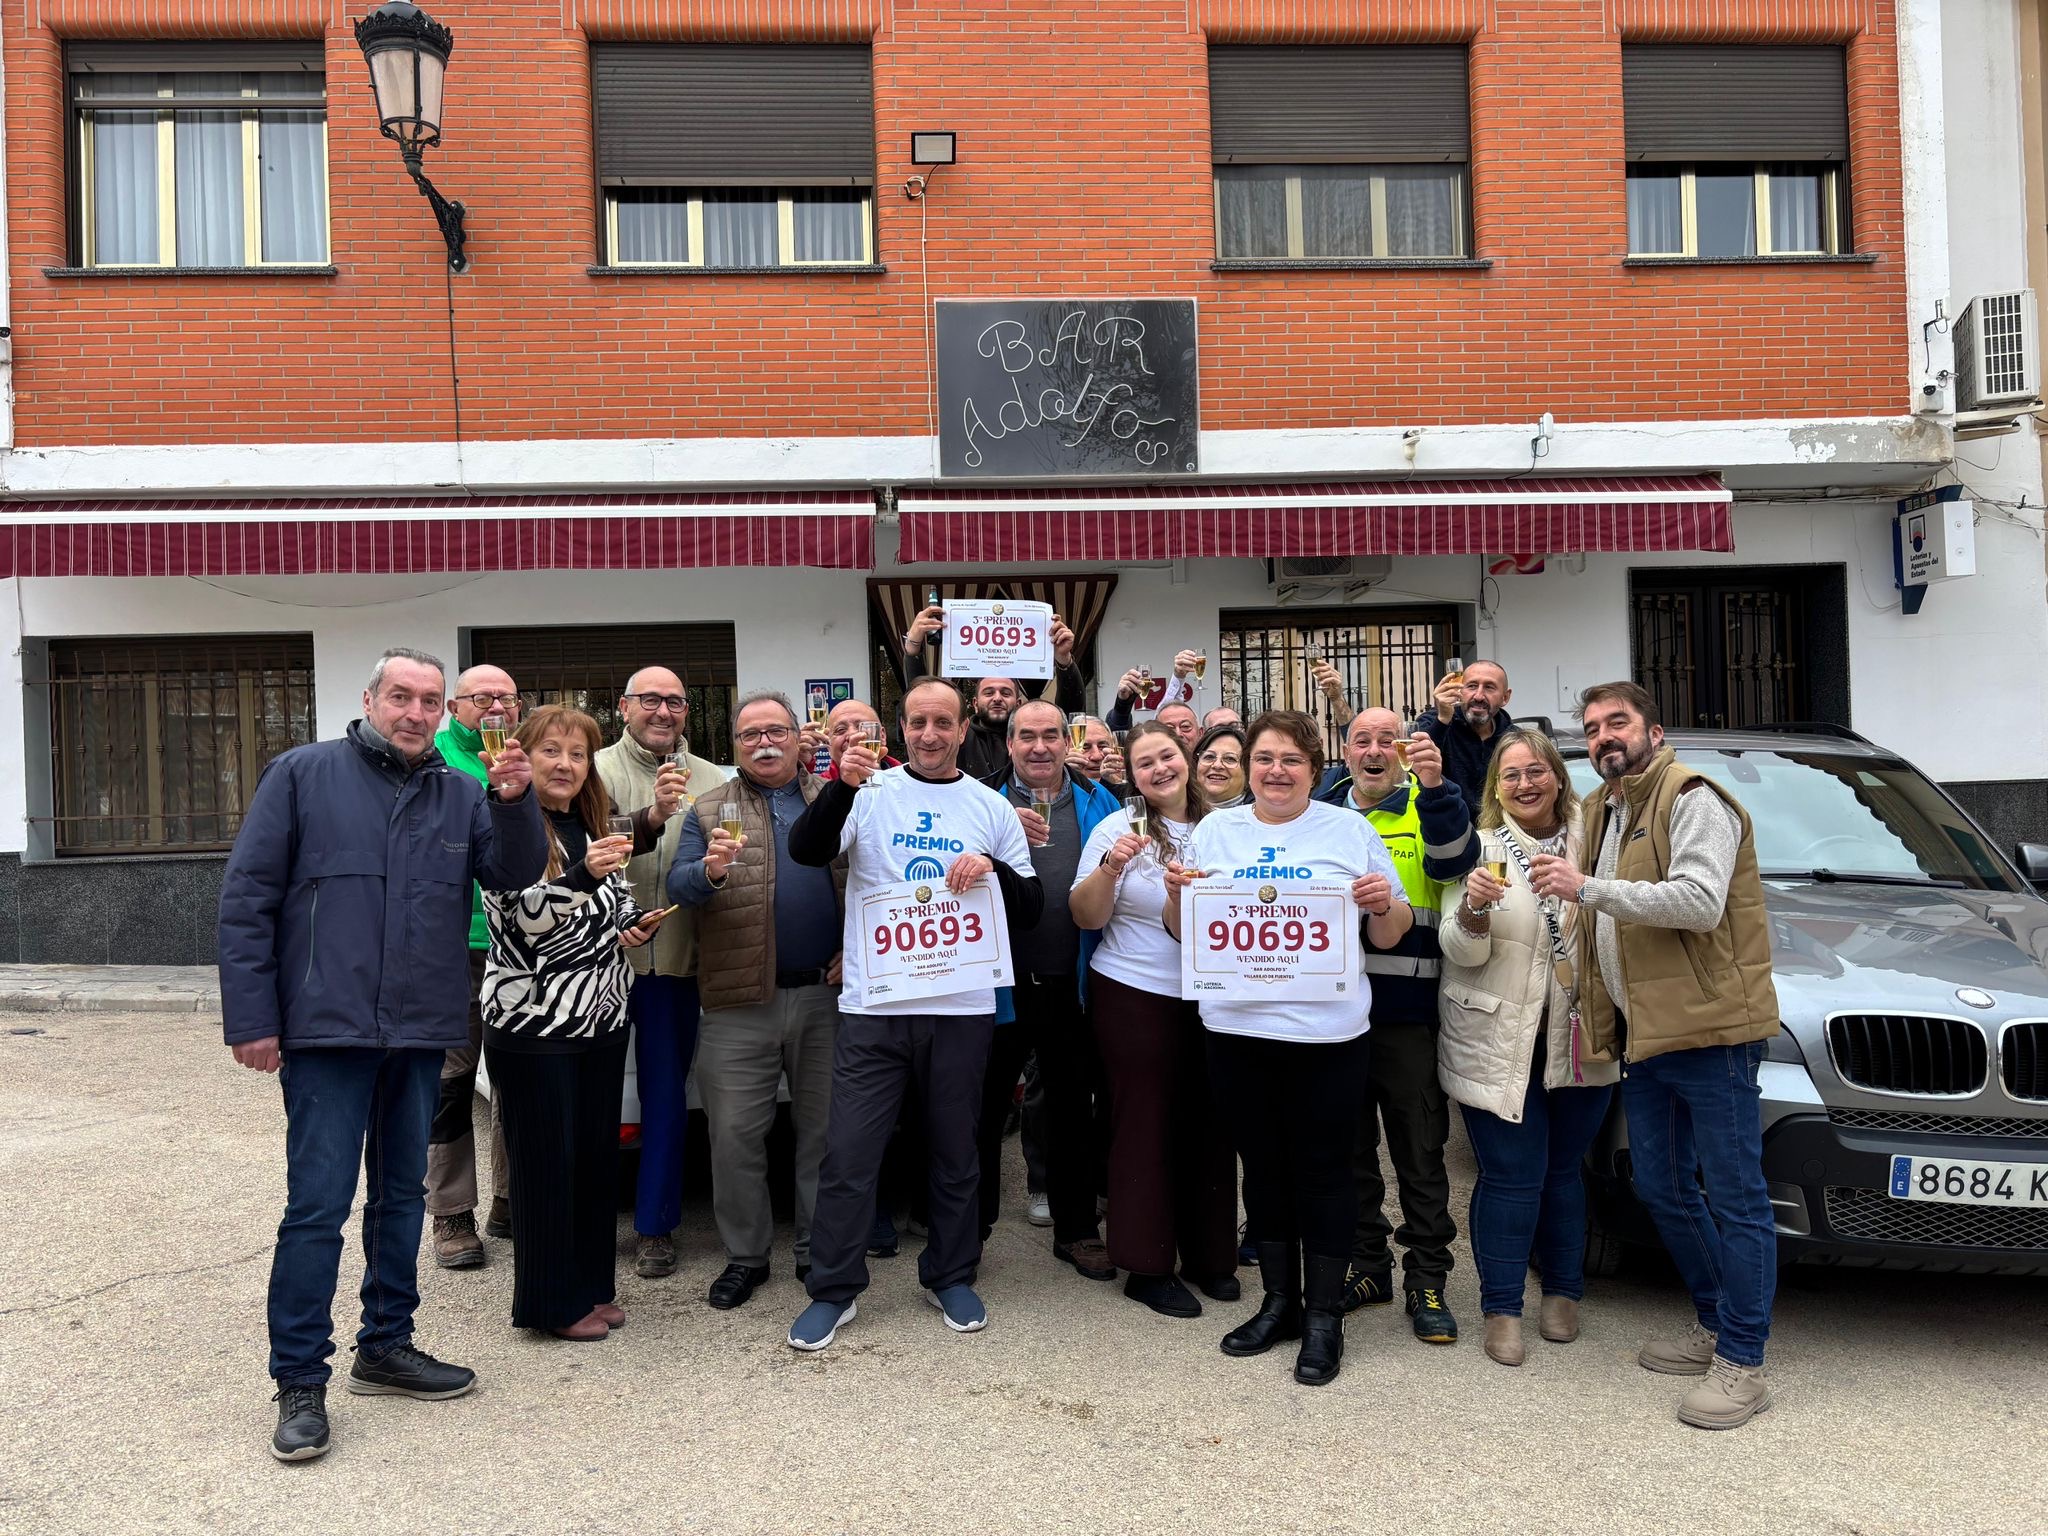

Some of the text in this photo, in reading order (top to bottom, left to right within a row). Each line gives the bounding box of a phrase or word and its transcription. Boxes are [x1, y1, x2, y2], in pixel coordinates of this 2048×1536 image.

[977, 311, 1155, 375] BAR
[1911, 568, 1926, 578] Estado
[984, 616, 1024, 626] PREMIO
[960, 625, 1037, 647] 90693
[892, 833, 964, 854] PREMIO
[904, 900, 961, 919] PREMIO
[1245, 905, 1308, 918] PREMIO
[874, 912, 984, 956] 90693
[1208, 920, 1330, 952] 90693
[900, 947, 958, 963] VENDIDO AQUÍ
[1236, 954, 1299, 965] VENDIDO AQUÍ
[1896, 1181, 1904, 1190] E
[1918, 1163, 2015, 1200] 8684
